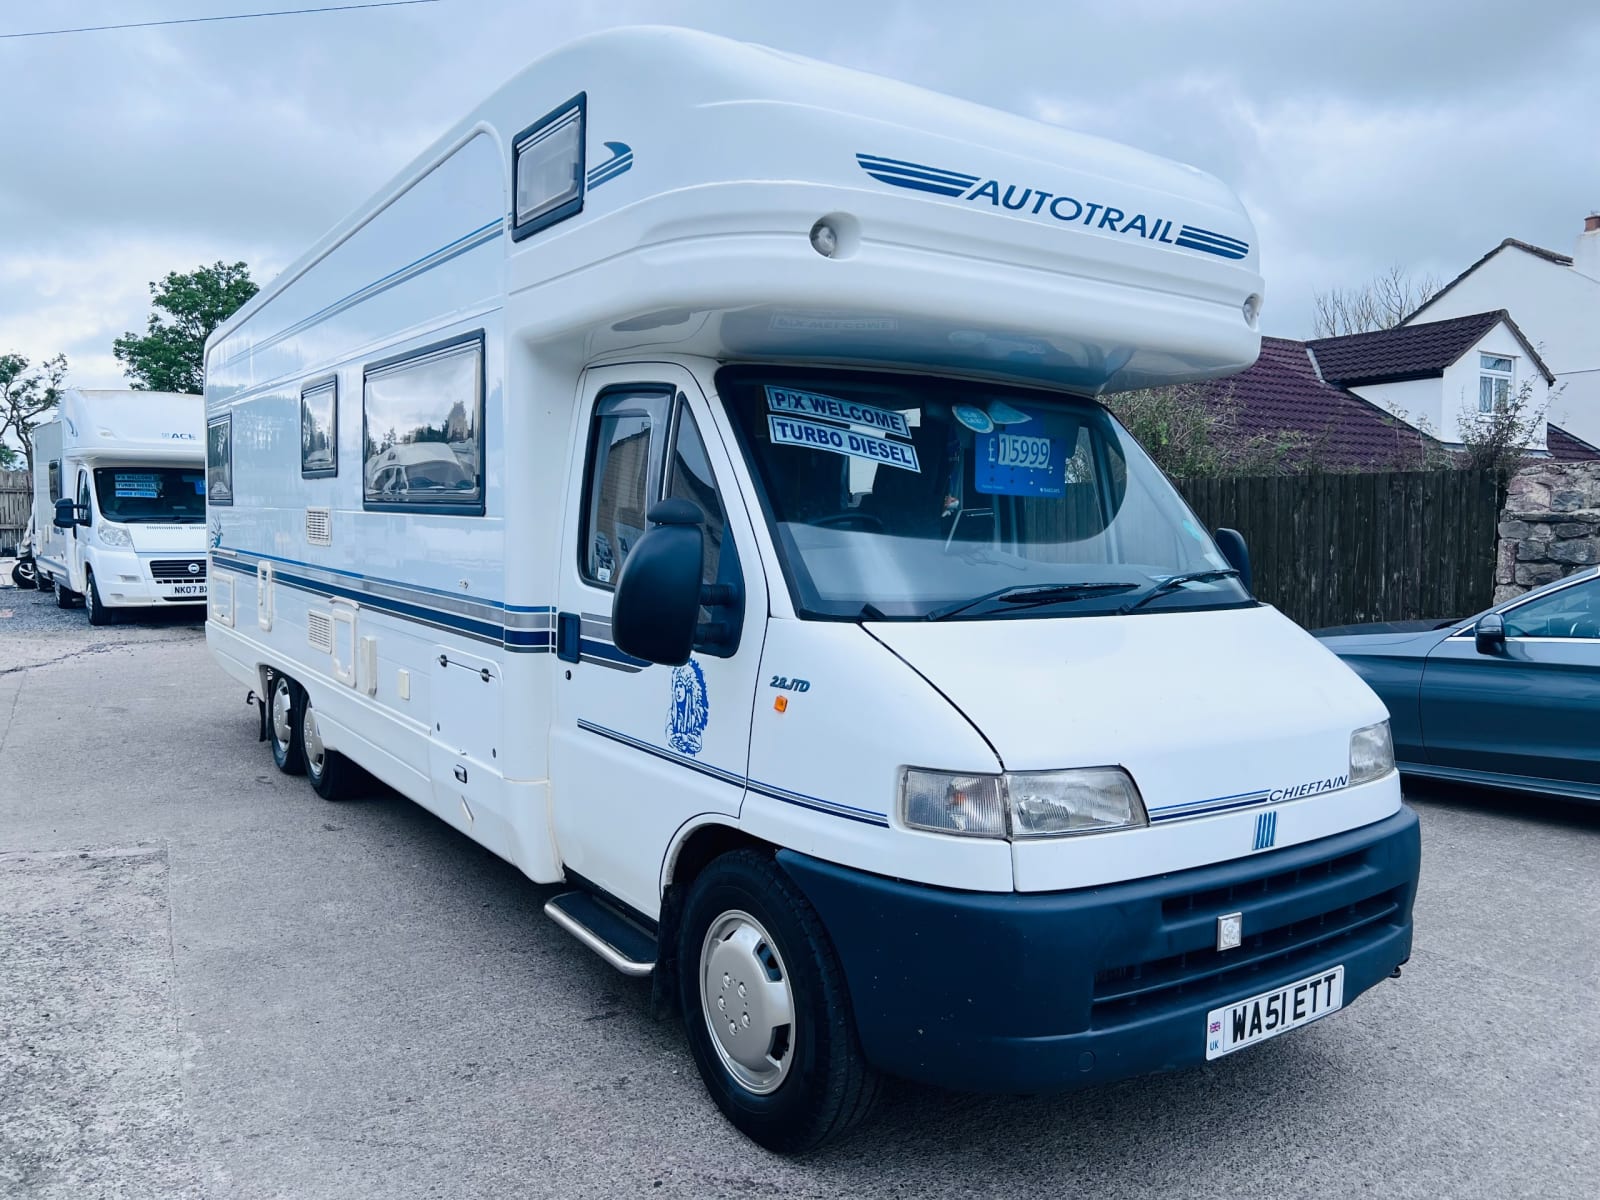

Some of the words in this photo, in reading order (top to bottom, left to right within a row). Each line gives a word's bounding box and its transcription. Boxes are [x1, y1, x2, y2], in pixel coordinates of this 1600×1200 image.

[966, 180, 1175, 244] AUTOTRAIL
[774, 391, 806, 411] P/X
[809, 397, 902, 431] WELCOME
[776, 421, 844, 448] TURBO
[849, 434, 914, 464] DIESEL
[174, 585, 197, 594] NK07
[1268, 775, 1348, 802] CHIEFTAIN
[1209, 1039, 1219, 1051] UK
